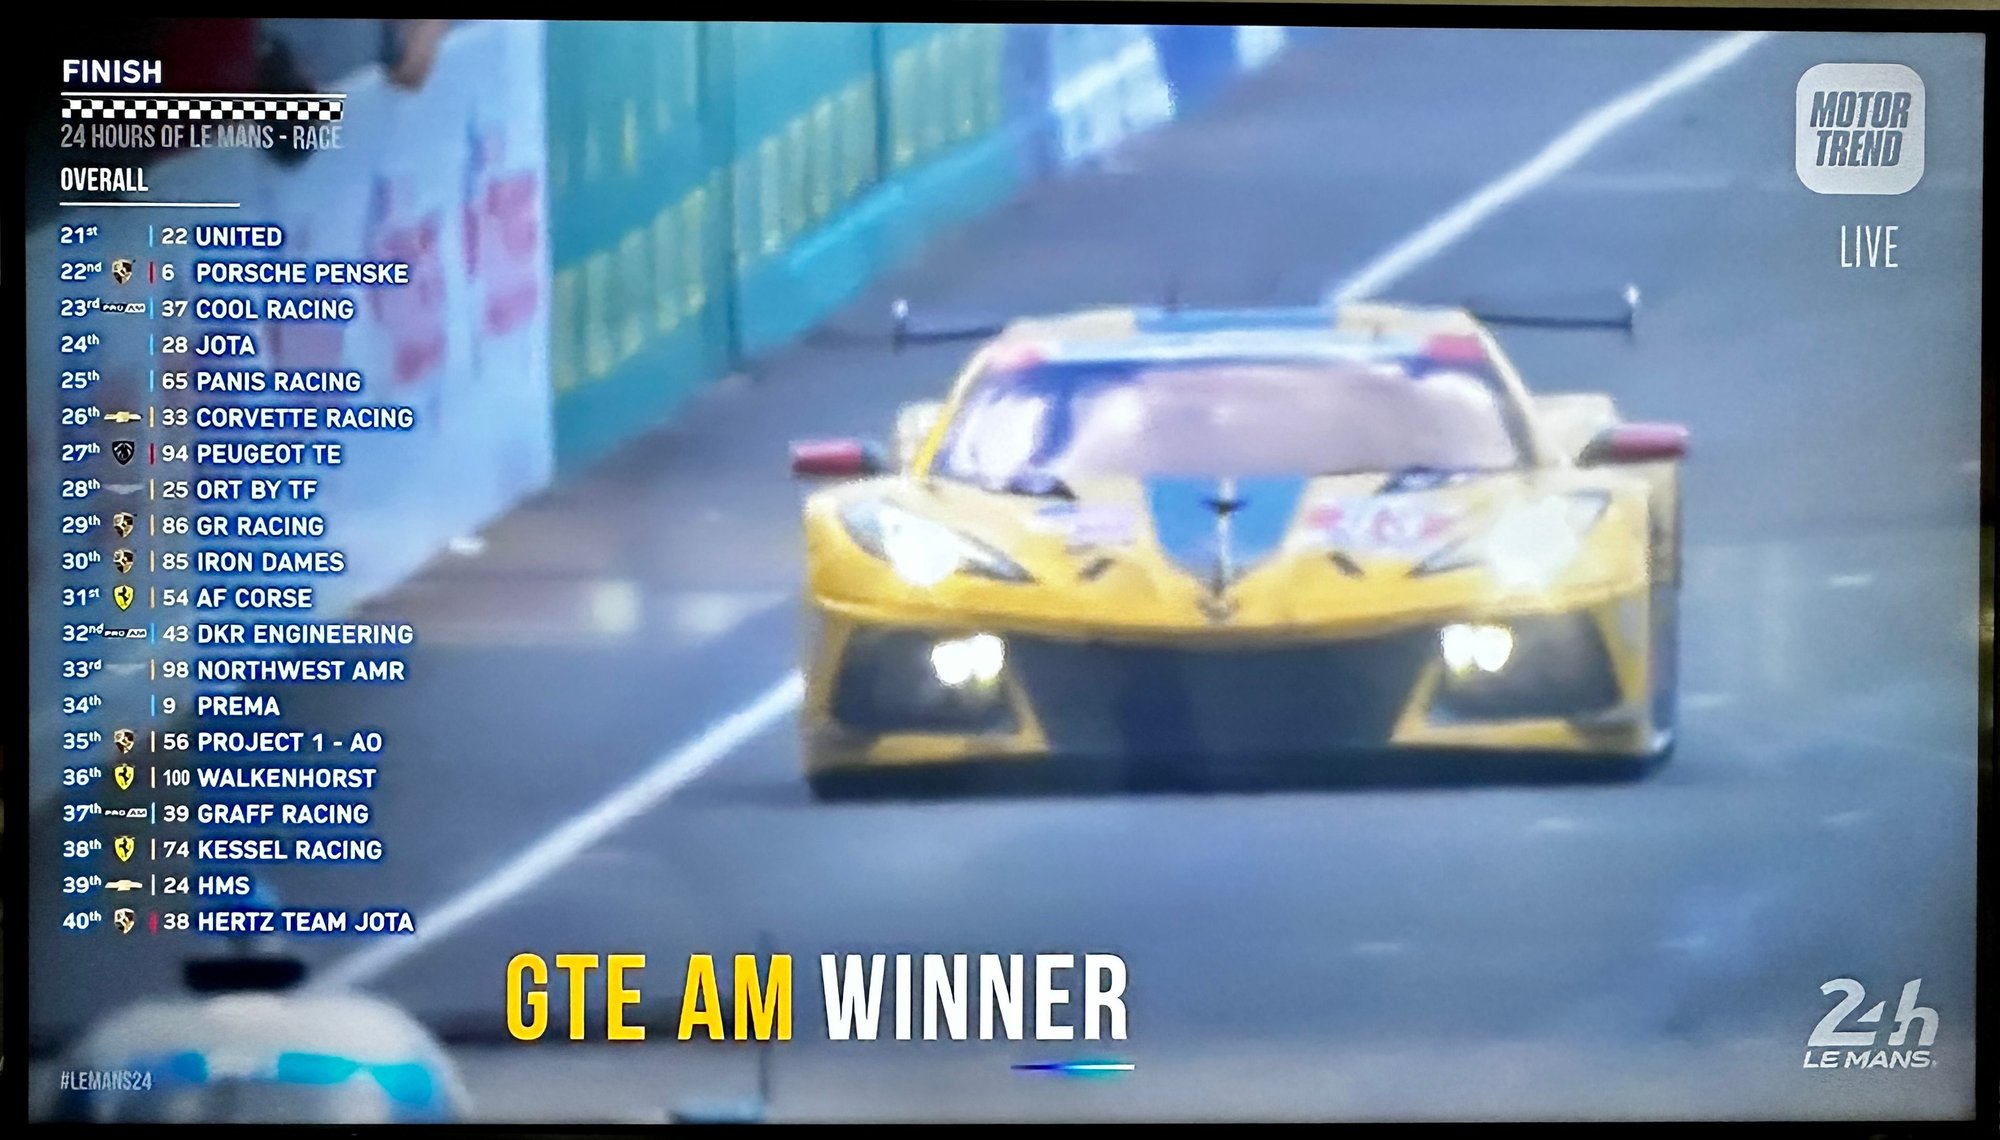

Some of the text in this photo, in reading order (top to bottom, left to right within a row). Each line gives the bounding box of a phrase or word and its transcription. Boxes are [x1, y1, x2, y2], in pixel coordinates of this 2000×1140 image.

[63, 59, 162, 84] FINISH
[1809, 91, 1912, 128] MOTOR
[60, 123, 86, 148] 24
[91, 123, 156, 148] HOURS
[161, 124, 185, 148] OF
[190, 124, 214, 149] LE
[217, 123, 274, 149] MANS
[293, 124, 344, 149] RACE
[1816, 130, 1903, 166] TREND
[60, 167, 149, 192] OVERALL
[60, 226, 282, 247] 21st 22 UNITED
[1840, 225, 1899, 268] LIVE
[60, 261, 409, 284] 22nd 6 PORSCHE PENSKE
[61, 297, 100, 317] 23rd
[161, 300, 189, 318] 37
[196, 298, 259, 319] COOL
[267, 299, 354, 320] RACING
[61, 333, 256, 355] 24th 28 JOTA
[61, 369, 361, 392] 25th 65 PANIS RACING
[61, 405, 413, 428] 26th 33 CORVETTE RACING
[62, 442, 341, 464] 27th 94 PEUGEOT TE
[62, 478, 318, 500] 28th 25 ORT BY TF
[62, 514, 324, 536] 29th 86 GR RACING
[62, 550, 344, 572] 30th 85 IRON DAMES
[62, 587, 313, 608] 31st 54 AF CORSE
[62, 622, 104, 642] 32nd
[162, 625, 189, 642] 43
[198, 624, 245, 644] DKR
[254, 624, 414, 644] ENGINEERING
[62, 659, 405, 681] 33rd 98 NORTHWEST AMR
[63, 694, 281, 716] 34th 9 PREMA
[63, 730, 102, 750] 35th
[163, 733, 190, 751] 56
[198, 732, 304, 752] PROJECT
[312, 733, 323, 752] 1
[349, 732, 382, 752] AO
[62, 766, 377, 788] 36th 100 WALKENHORST
[63, 802, 102, 822] 37th
[163, 804, 190, 823] 39
[197, 803, 274, 824] GRAFF
[282, 804, 369, 824] RACING
[63, 838, 382, 860] 38th 74 KESSEL RACING
[62, 874, 250, 895] 39th 24 HMS
[62, 910, 414, 932] 40th 38 HERTZ TEAM JOTA
[507, 953, 1128, 1040] GTE AM WINNER
[1807, 978, 1939, 1047] 24h
[1803, 1050, 1841, 1069] LE
[60, 1070, 152, 1091] #LEMANS24
